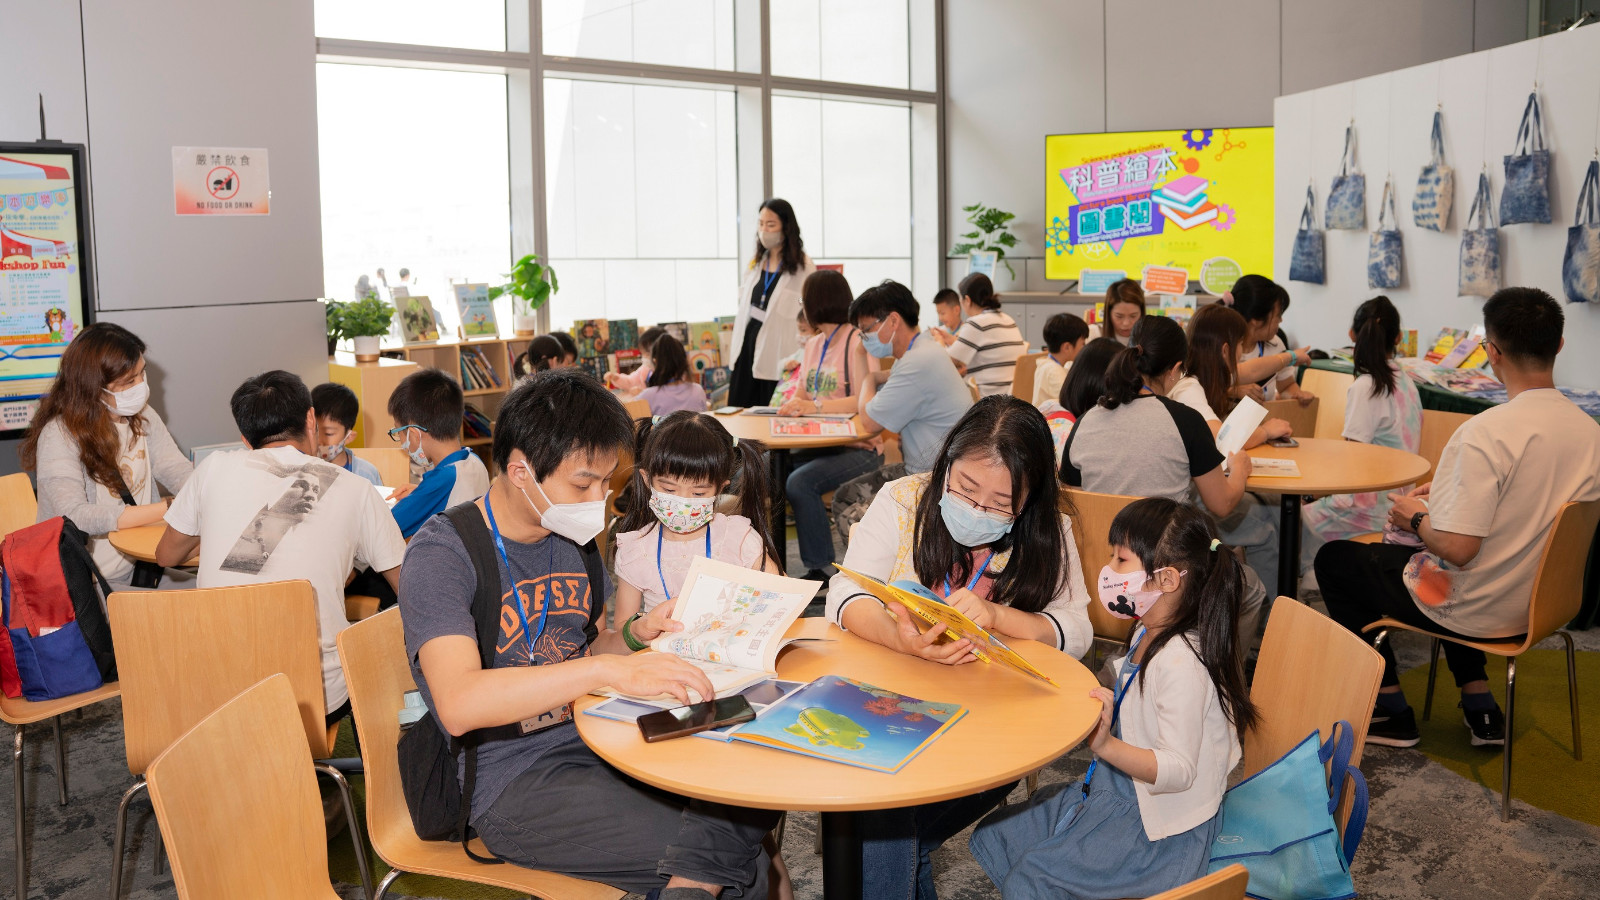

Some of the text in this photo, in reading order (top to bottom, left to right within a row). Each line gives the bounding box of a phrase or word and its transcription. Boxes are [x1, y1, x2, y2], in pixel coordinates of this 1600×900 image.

[1069, 148, 1178, 194] 科普繪本
[1078, 199, 1151, 237] 圖書閣
